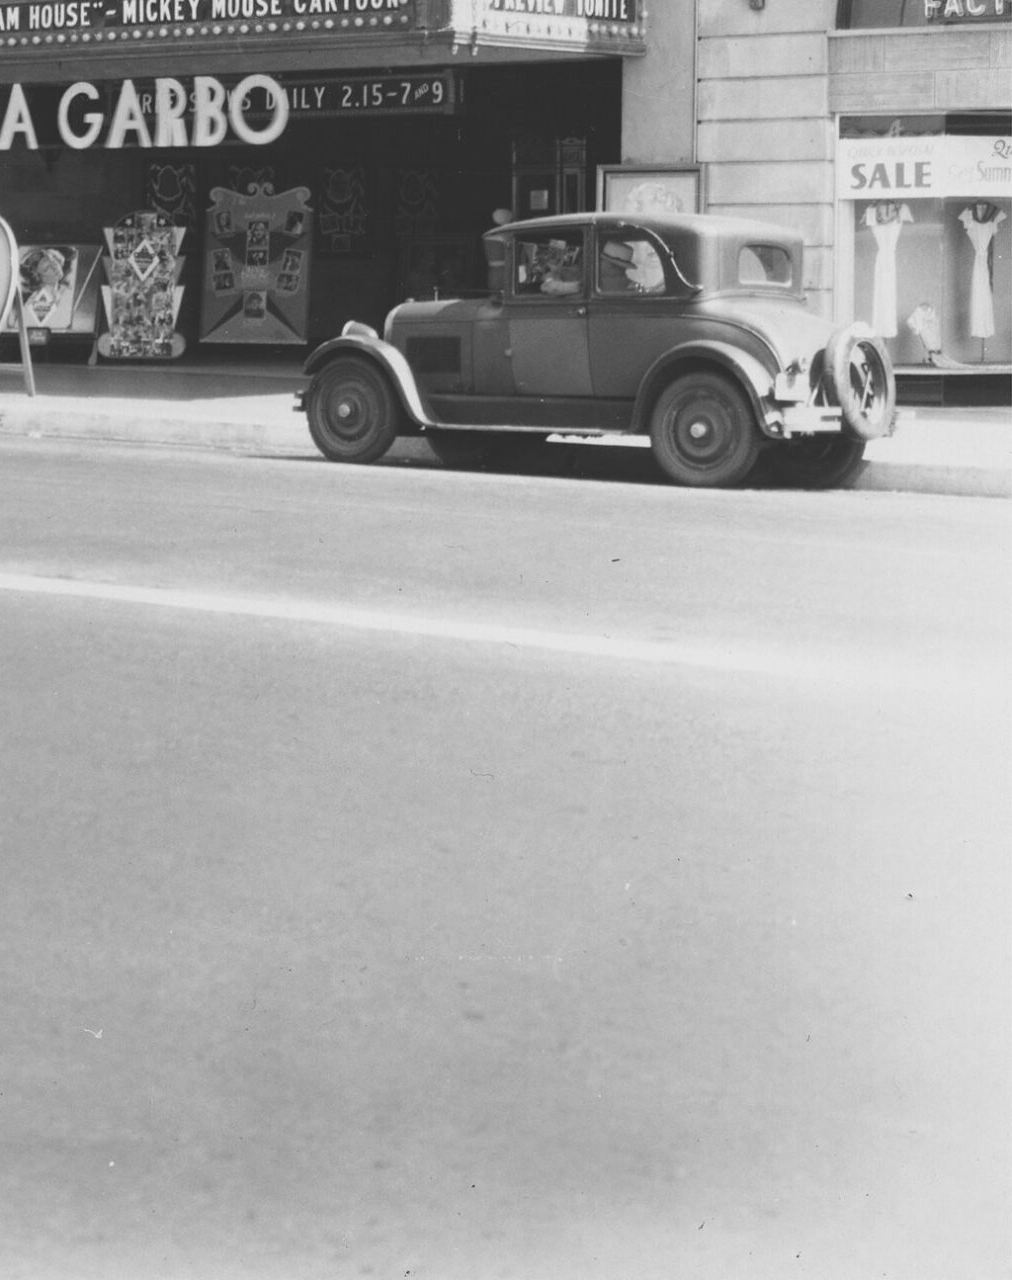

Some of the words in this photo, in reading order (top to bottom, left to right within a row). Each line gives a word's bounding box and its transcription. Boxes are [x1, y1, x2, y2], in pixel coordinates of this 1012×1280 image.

[266, 86, 326, 111] DILY
[414, 83, 429, 100] AND
[432, 81, 444, 104] 9
[57, 74, 289, 150] GARBO
[850, 162, 932, 190] SALE
